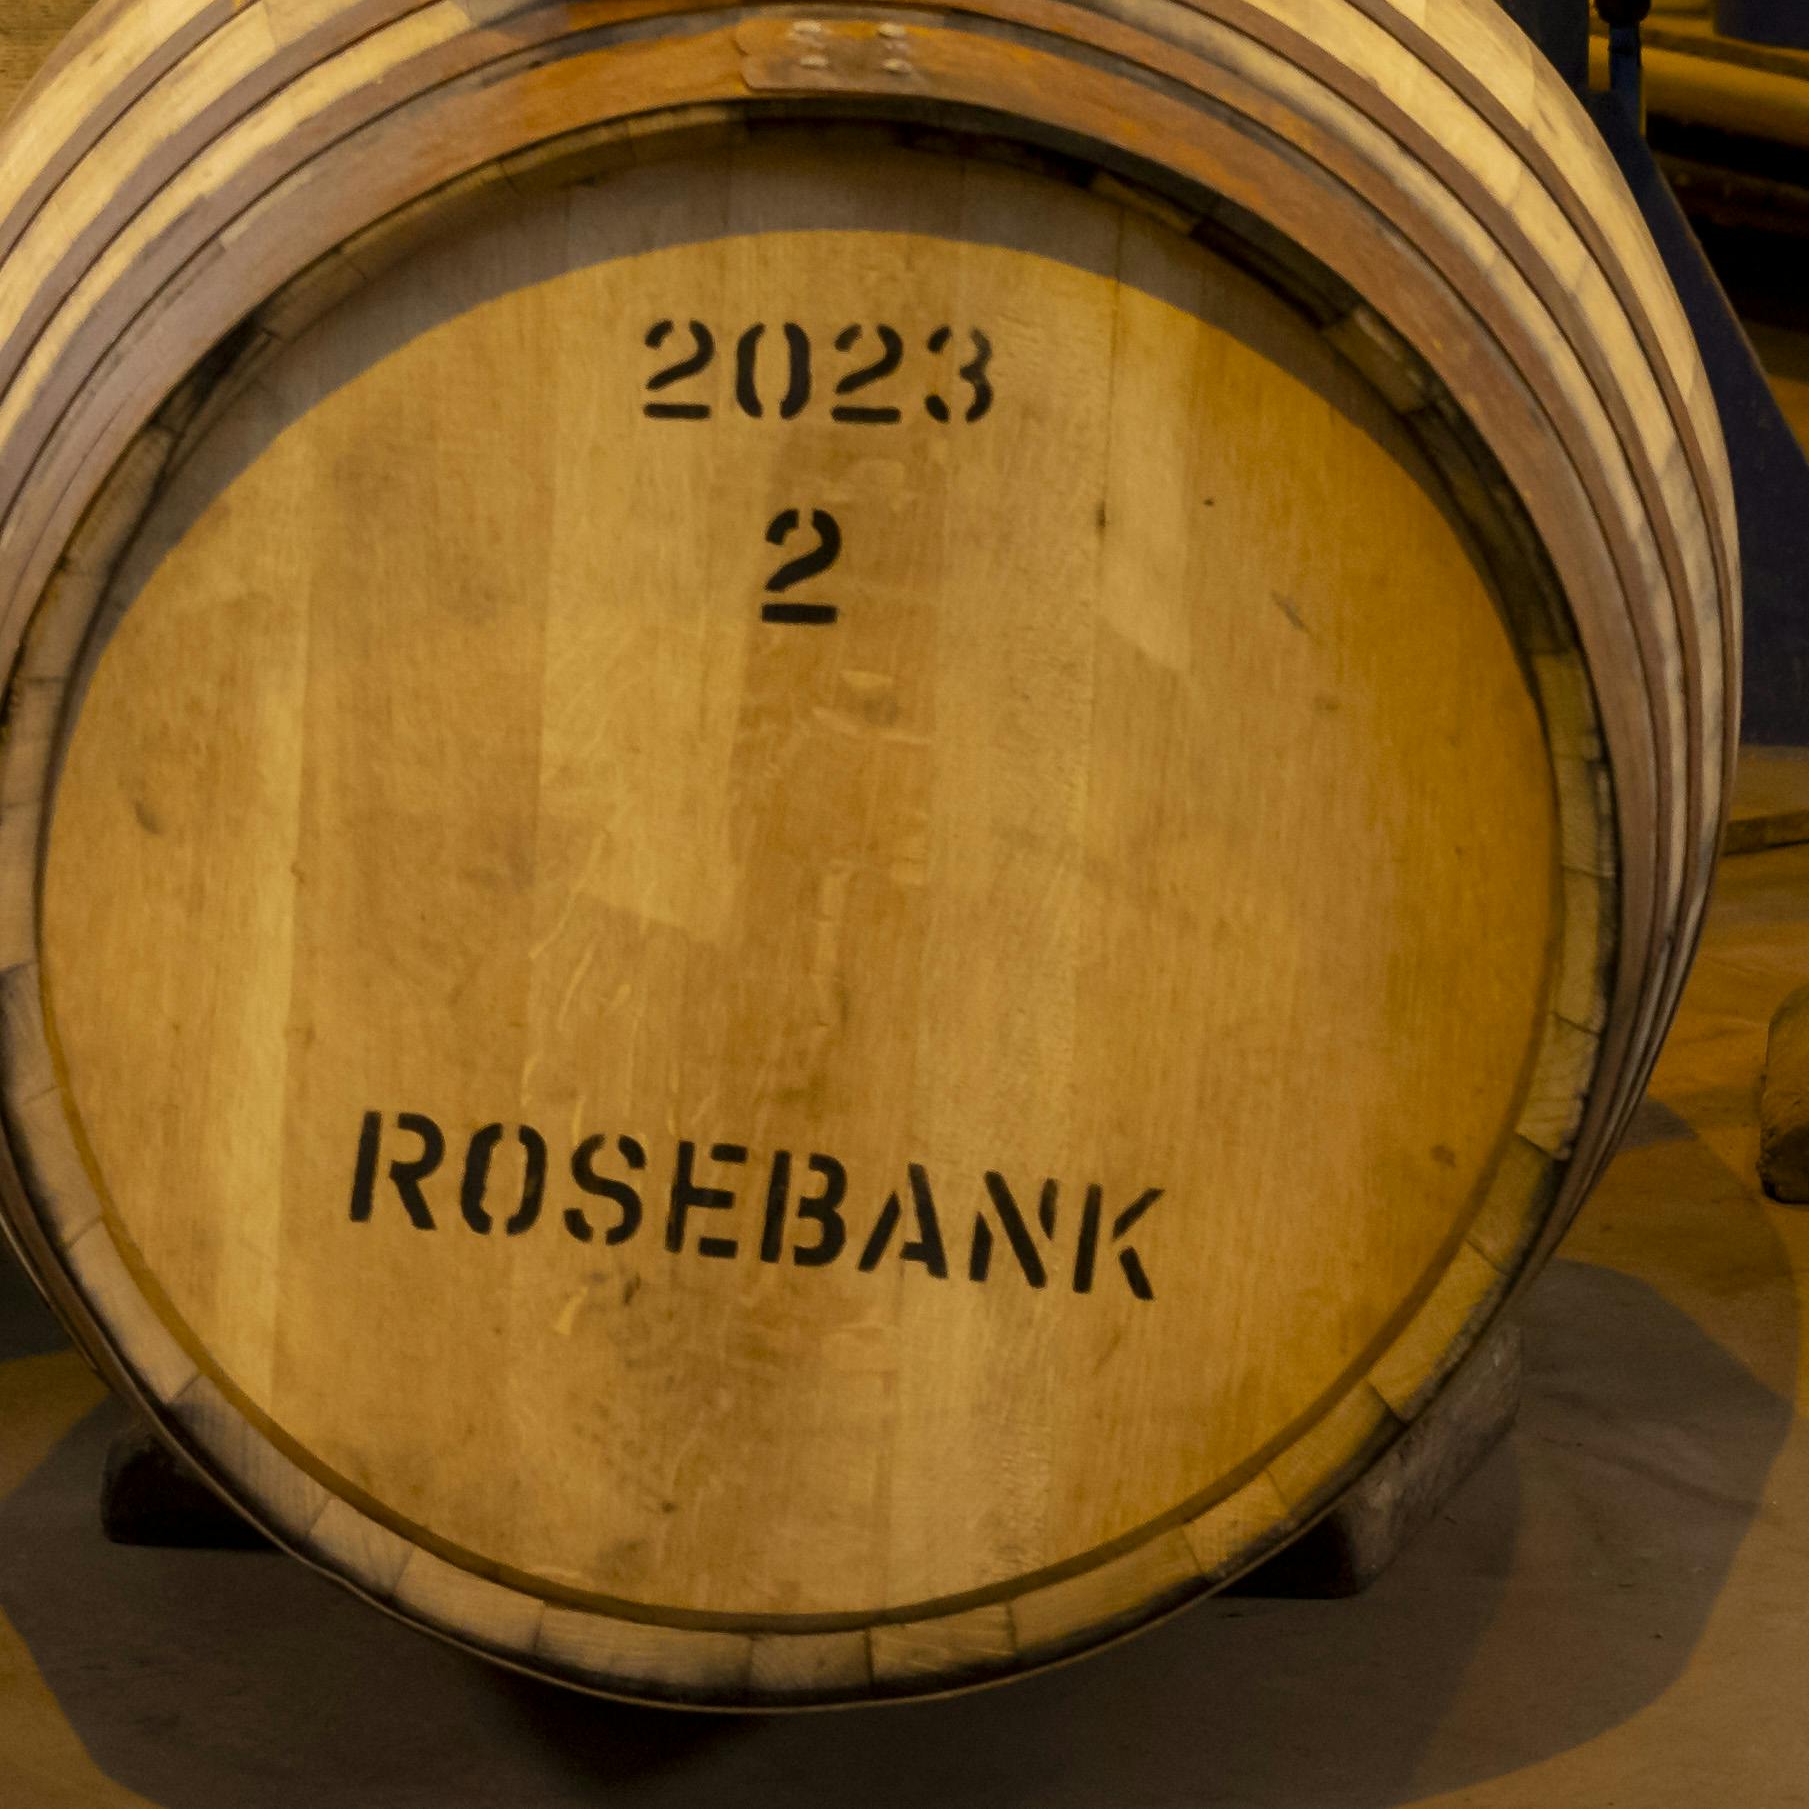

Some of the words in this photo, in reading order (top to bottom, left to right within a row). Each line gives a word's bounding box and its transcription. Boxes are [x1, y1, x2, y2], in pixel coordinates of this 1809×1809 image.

[643, 319, 994, 425] 2023
[762, 508, 843, 626] 2
[349, 1111, 1167, 1303] ROSEBANK
